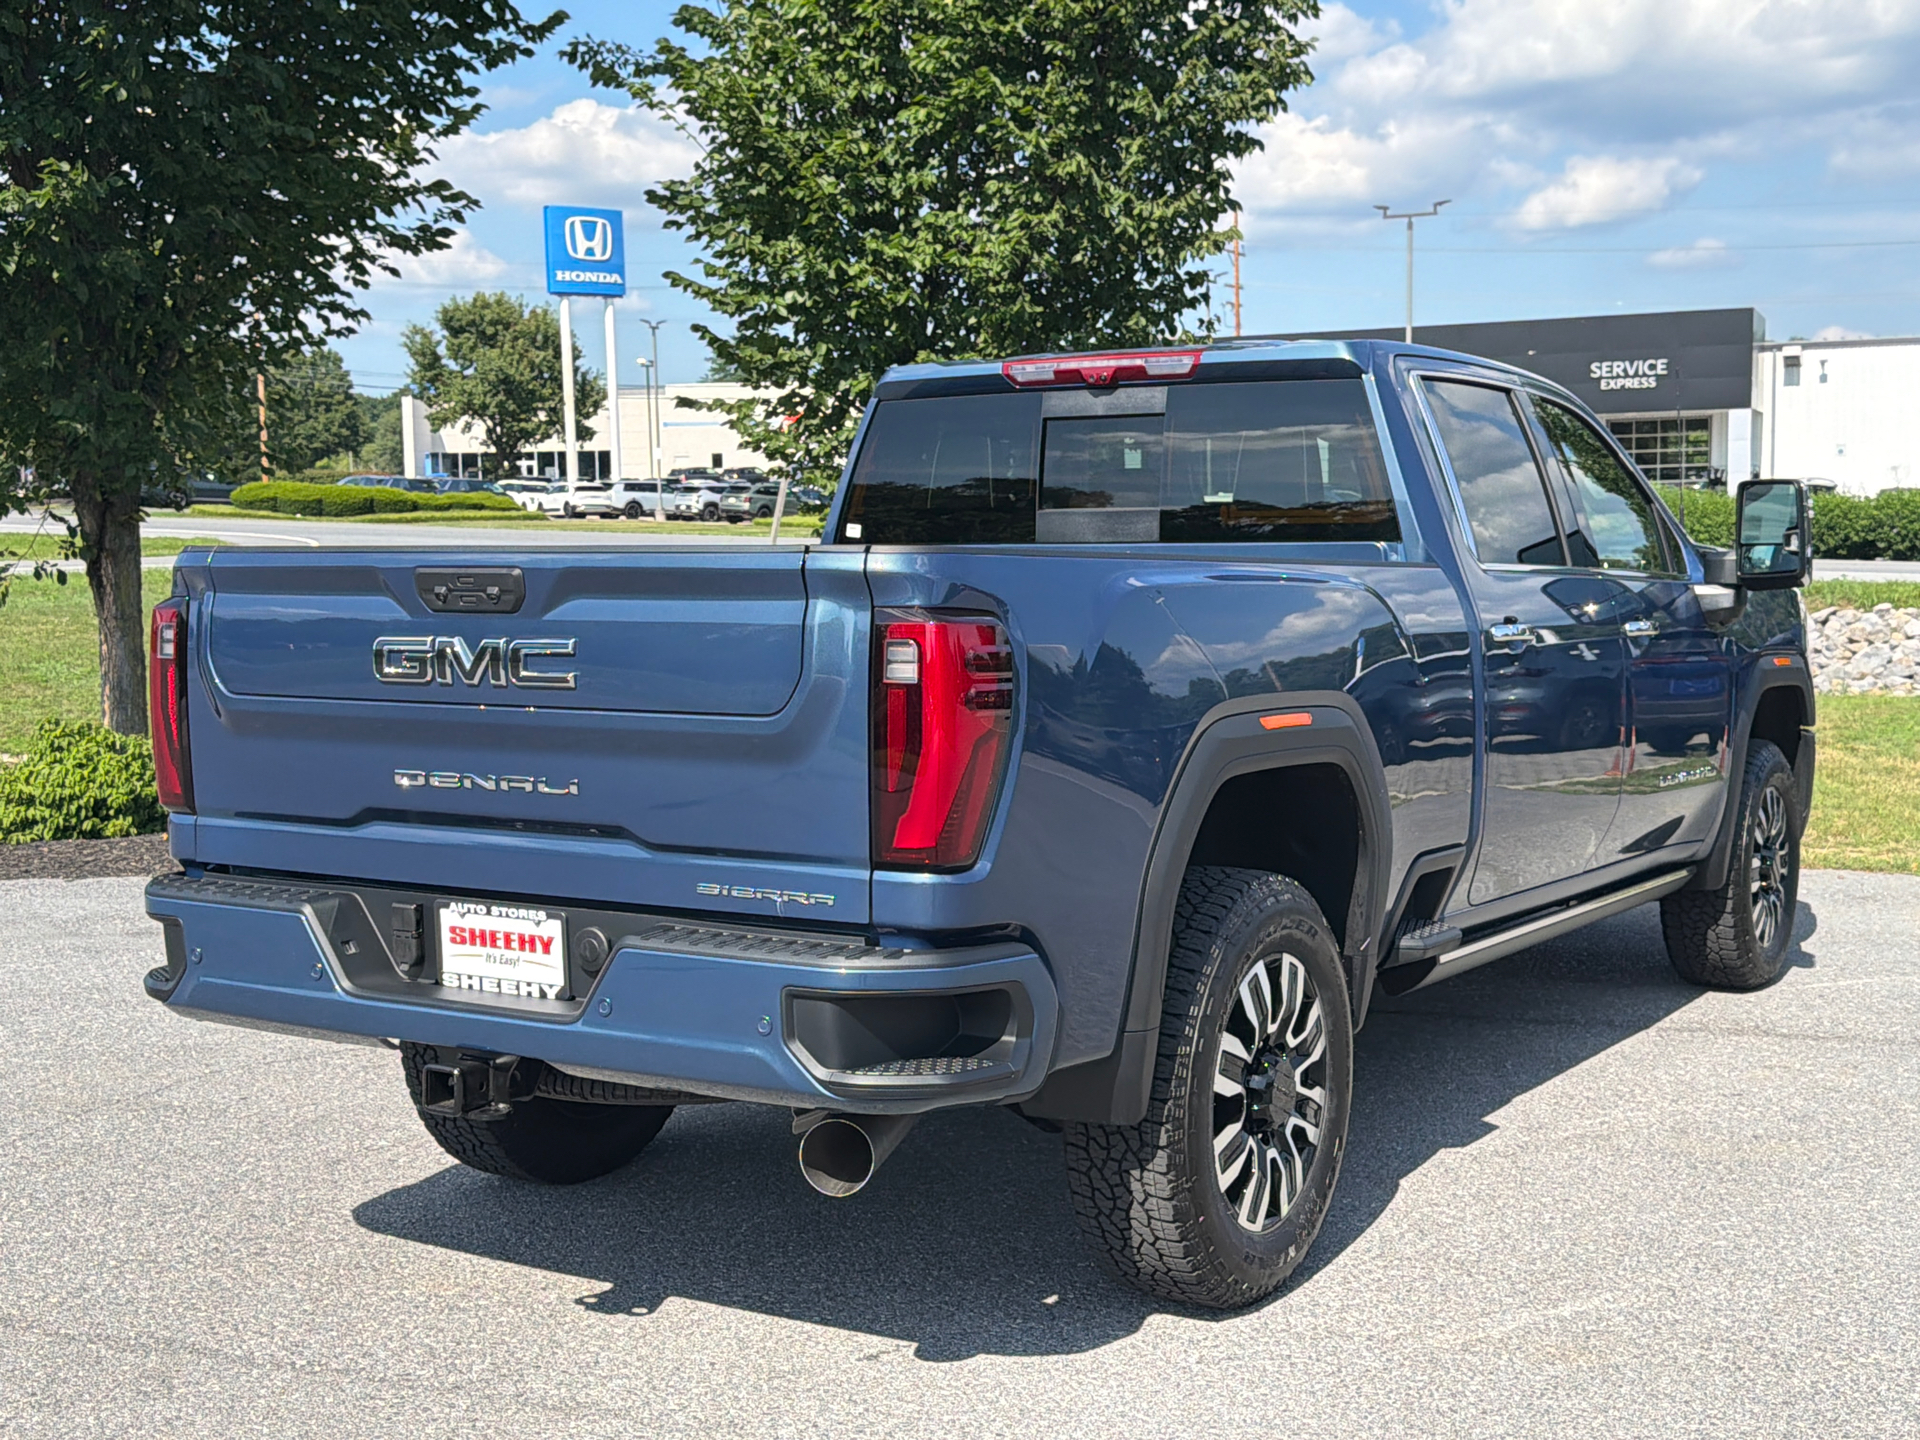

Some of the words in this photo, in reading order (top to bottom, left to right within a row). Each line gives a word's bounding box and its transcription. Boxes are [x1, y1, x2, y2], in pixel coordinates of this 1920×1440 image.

[555, 270, 624, 284] HONDA
[1589, 358, 1669, 379] SERVICE
[1600, 376, 1657, 391] EXPRESS
[373, 636, 579, 689] GMC
[394, 768, 580, 796] DENALI
[696, 882, 836, 907] SIERRA
[449, 902, 487, 915] AUTO
[490, 905, 548, 922] STORES
[449, 925, 556, 955] SHEEHY
[485, 952, 498, 964] It's
[499, 953, 521, 969] Easy!
[442, 972, 562, 1000] SHEEHY
